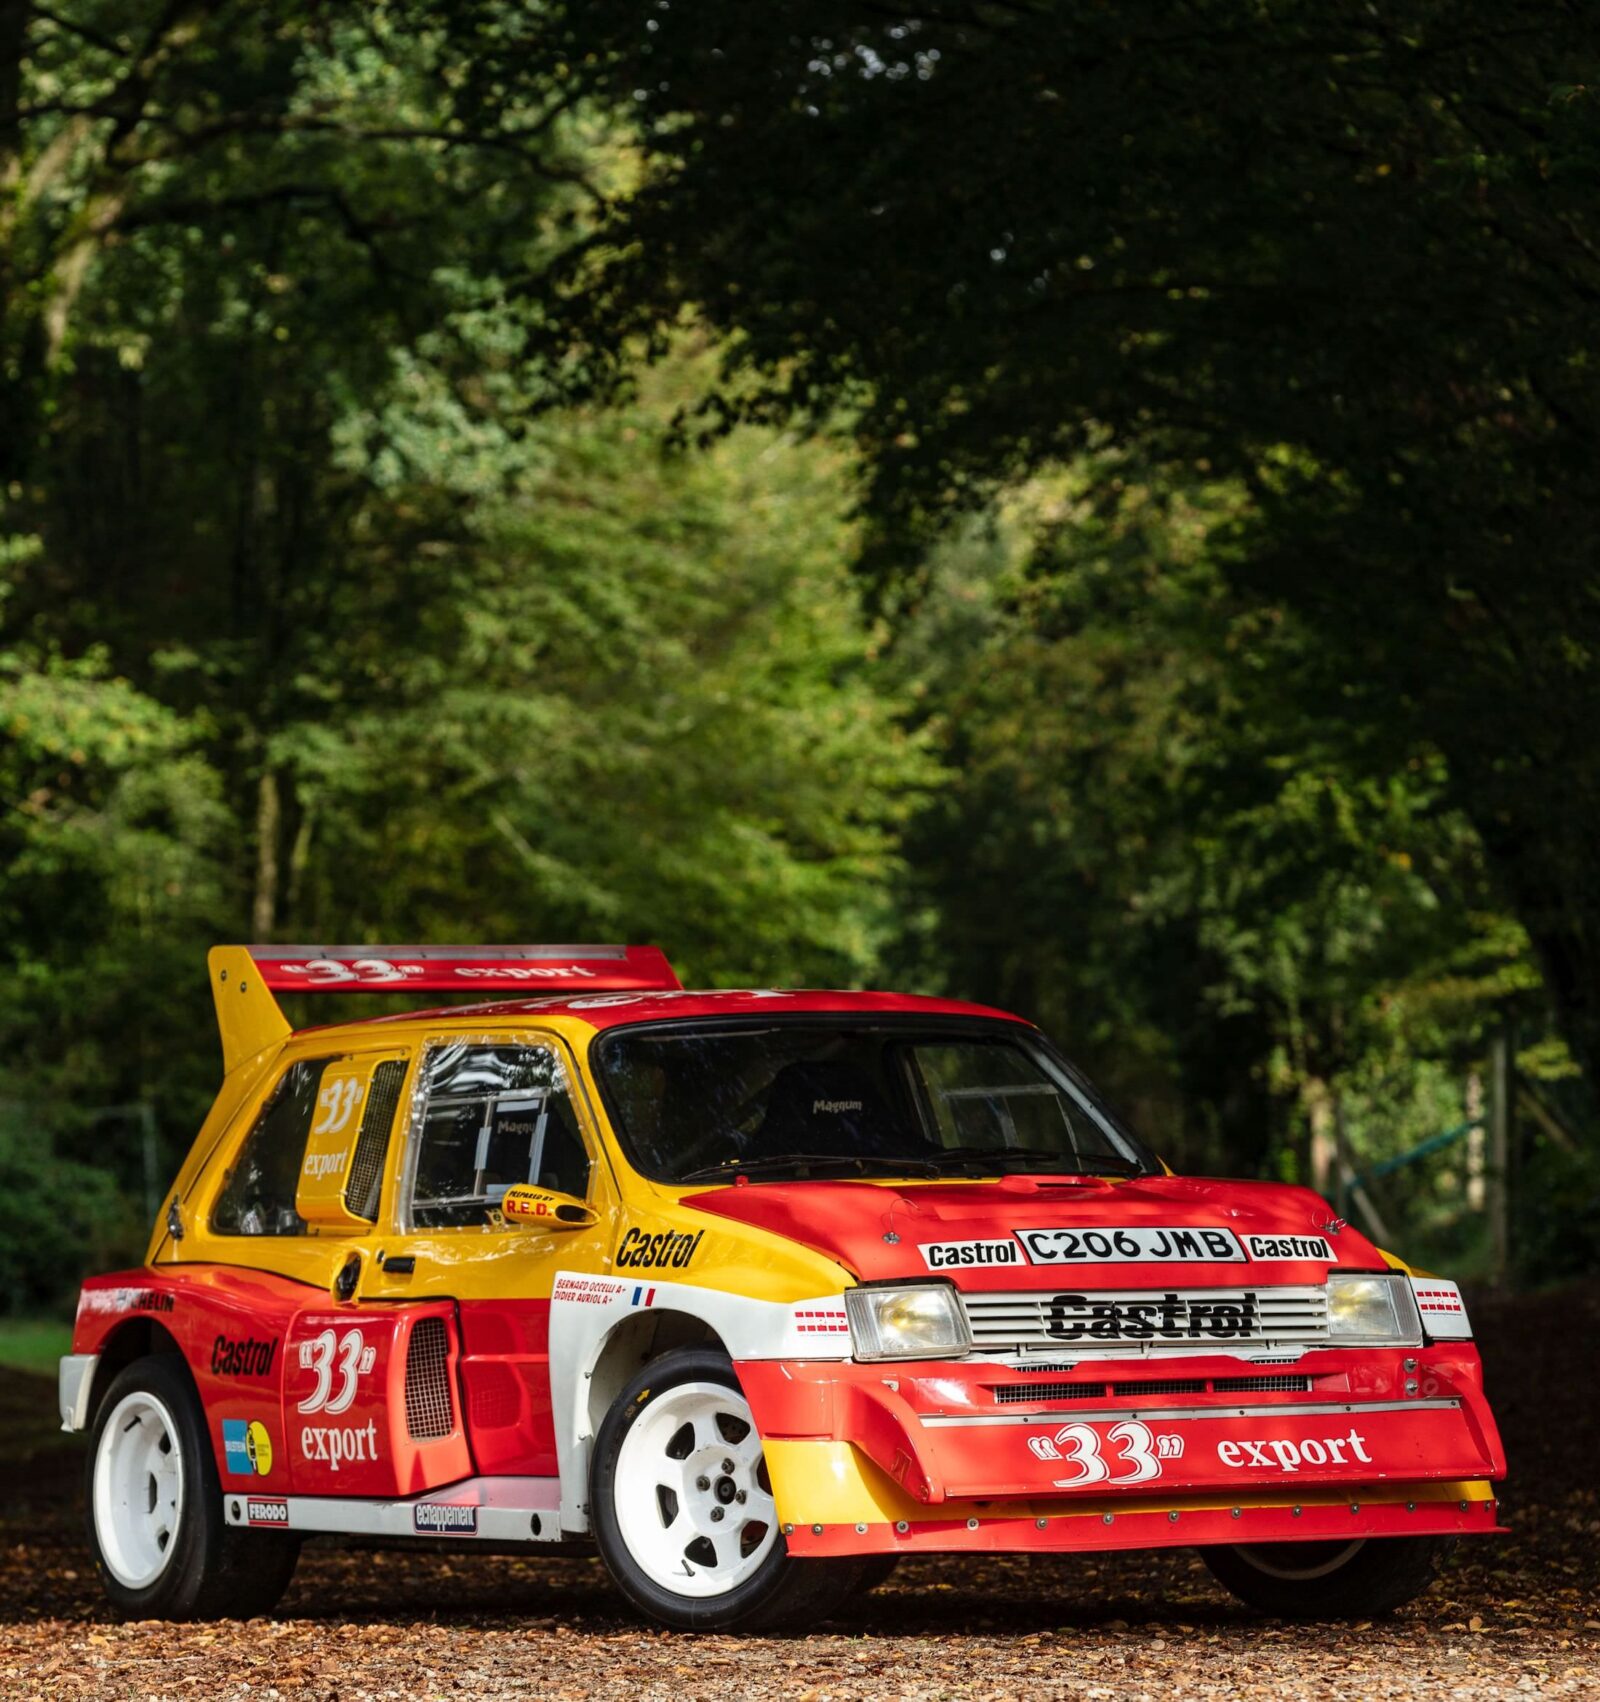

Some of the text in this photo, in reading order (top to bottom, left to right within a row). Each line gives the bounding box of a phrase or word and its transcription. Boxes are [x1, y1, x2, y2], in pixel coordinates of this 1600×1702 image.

[454, 965, 596, 979] export
[812, 1100, 862, 1114] Magnum
[497, 1120, 535, 1135] Magnu
[304, 1146, 348, 1180] export
[506, 1200, 553, 1217] R.E.D.
[615, 1227, 705, 1268] Castrol
[928, 1241, 1018, 1267] Castrol
[1026, 1230, 1234, 1260] C206 JMB
[1249, 1236, 1330, 1259] Castrol
[553, 1290, 576, 1301] DIDIER
[575, 1293, 601, 1304] AURIOL
[556, 1278, 589, 1291] BERNARD
[588, 1282, 616, 1293] OCCELLI
[1048, 1292, 1256, 1340] Castrol
[210, 1335, 278, 1376] Castrol
[301, 1418, 378, 1471] export
[1216, 1428, 1373, 1472] export
[249, 1503, 287, 1521] FERODO
